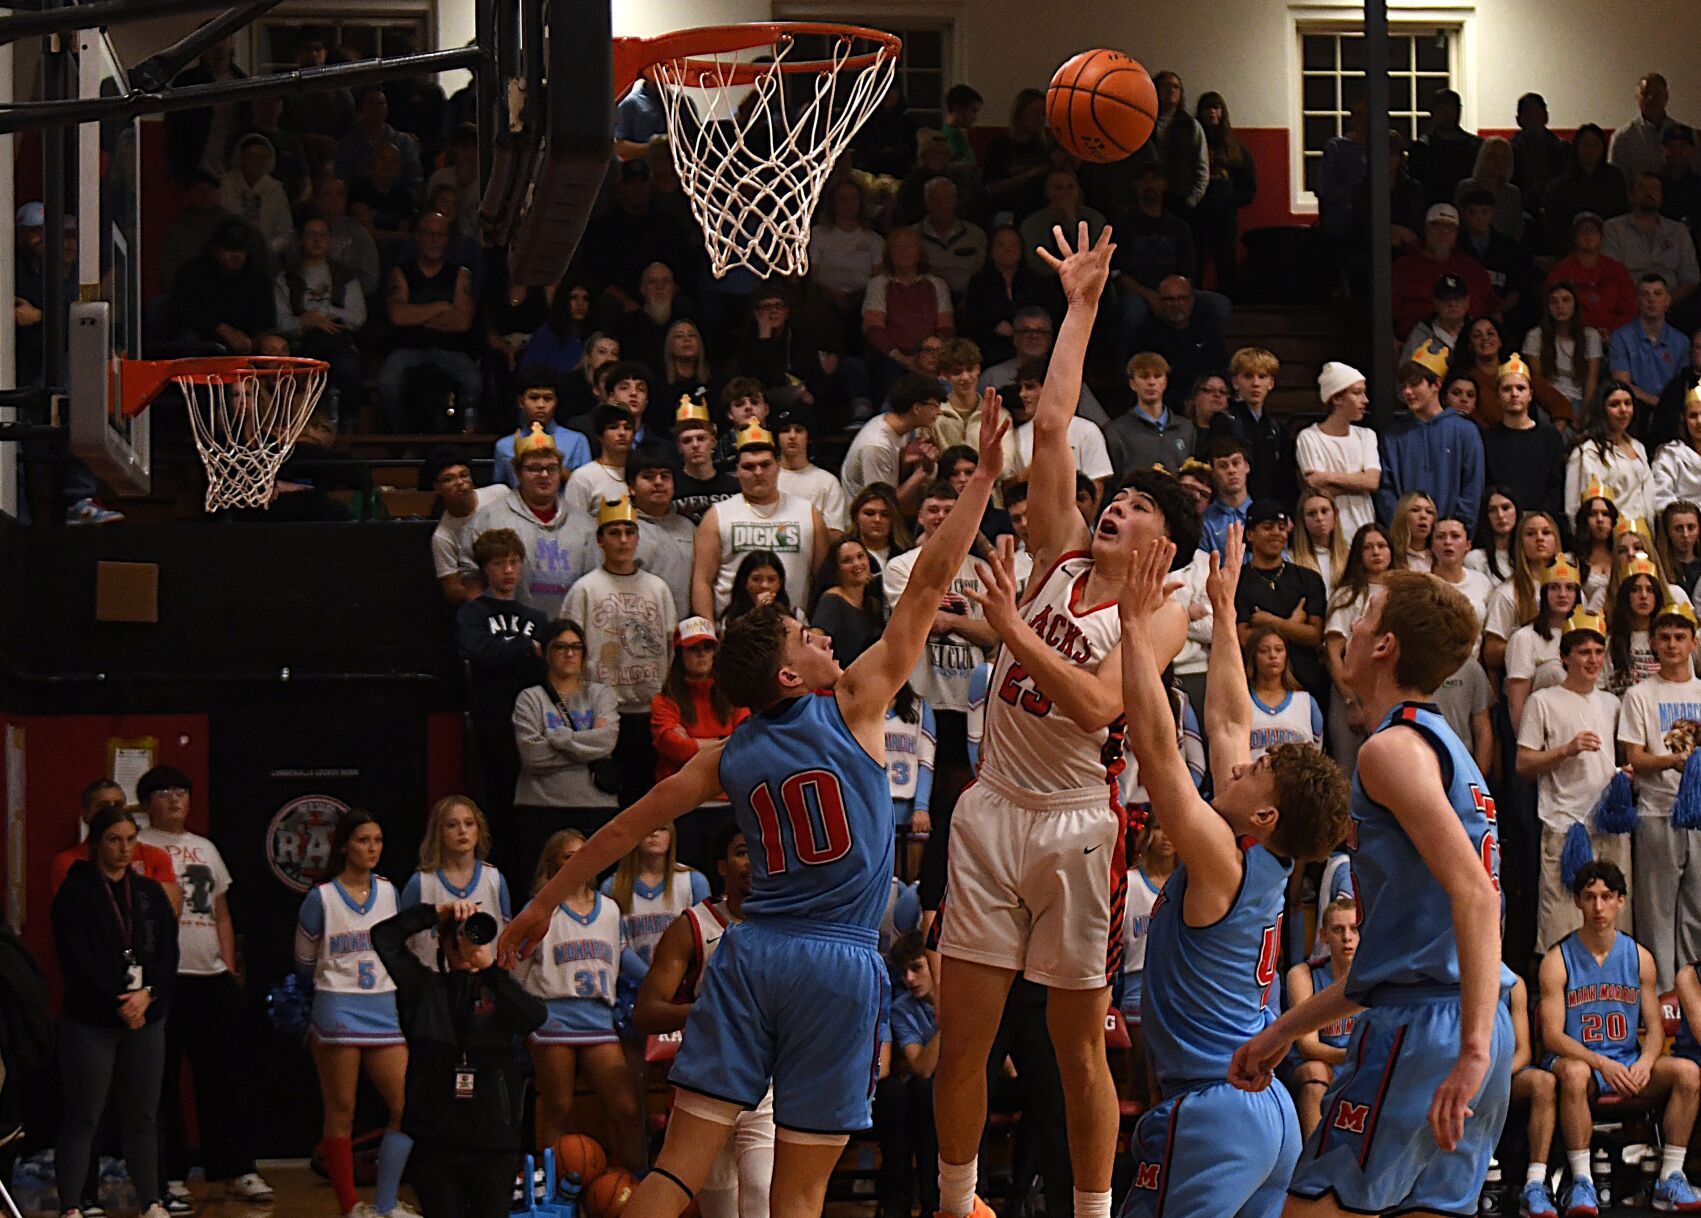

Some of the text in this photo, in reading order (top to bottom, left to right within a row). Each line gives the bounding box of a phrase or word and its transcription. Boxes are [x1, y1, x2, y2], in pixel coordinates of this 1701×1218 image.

[1028, 604, 1091, 664] ACKS
[749, 768, 853, 876] 10
[358, 960, 376, 990] 5
[575, 969, 609, 997] 31
[1567, 984, 1597, 1008] MARK
[1582, 1012, 1628, 1042] 20
[1333, 1099, 1370, 1134] M
[1134, 1160, 1161, 1190] M
